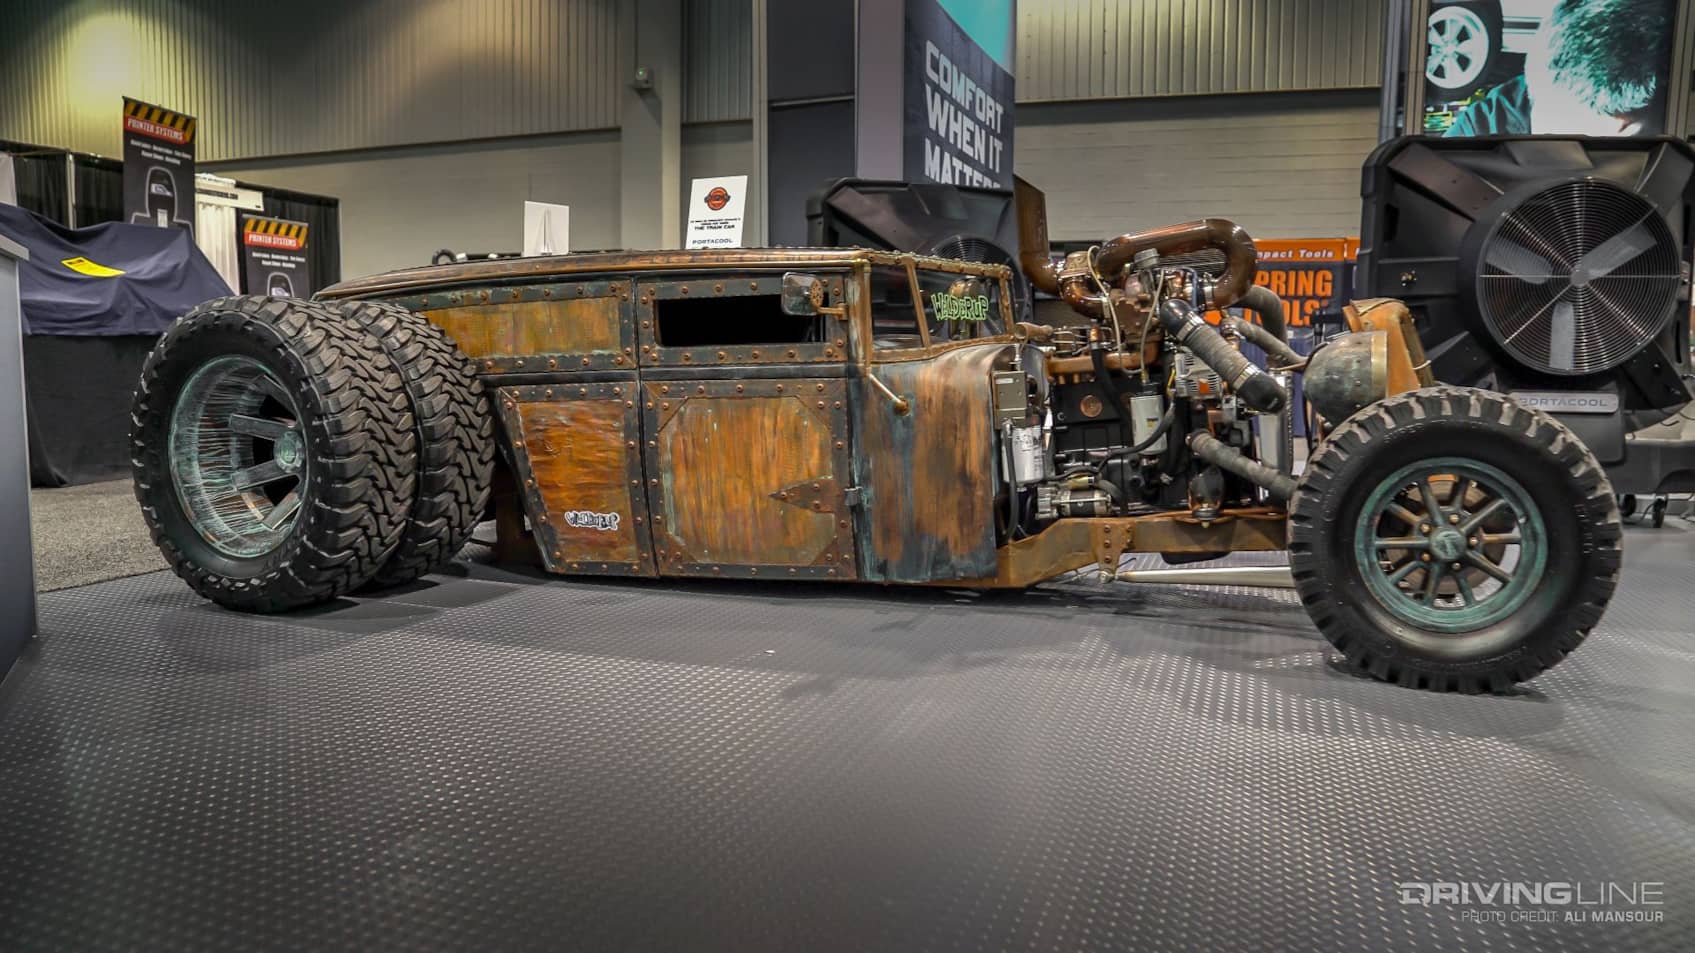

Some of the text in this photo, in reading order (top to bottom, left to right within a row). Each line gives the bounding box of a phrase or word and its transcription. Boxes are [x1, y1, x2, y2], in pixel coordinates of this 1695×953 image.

[925, 39, 1004, 134] COMFORT
[925, 82, 1003, 174] WHEN IT
[924, 137, 1001, 189] MATTE
[1299, 249, 1334, 259] Tools
[1254, 270, 1333, 297] PRING
